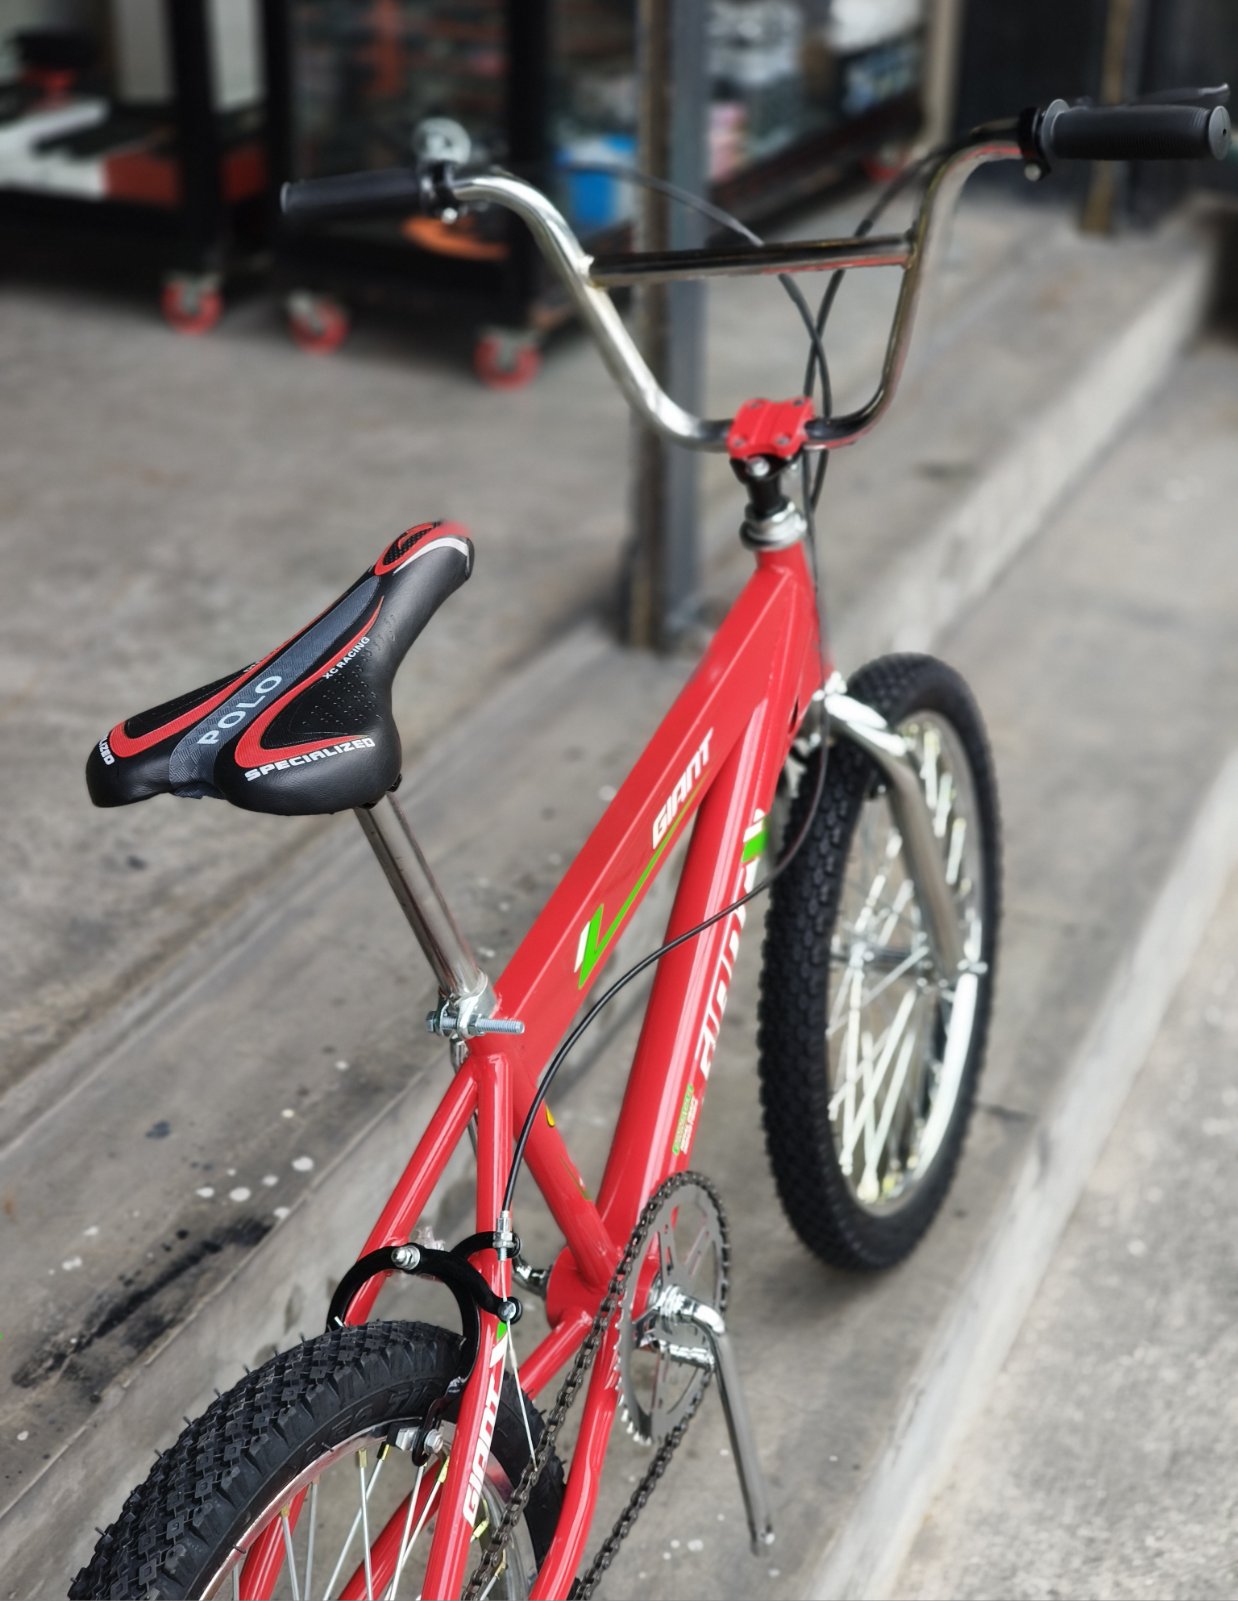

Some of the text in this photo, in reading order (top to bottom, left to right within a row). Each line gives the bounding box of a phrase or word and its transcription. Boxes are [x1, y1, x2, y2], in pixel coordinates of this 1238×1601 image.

[322, 636, 370, 680] XC RACING
[197, 675, 282, 745] POLO
[244, 737, 376, 782] SPECIALIZED
[652, 727, 714, 850] GIANT
[462, 1373, 502, 1528] GIANT
